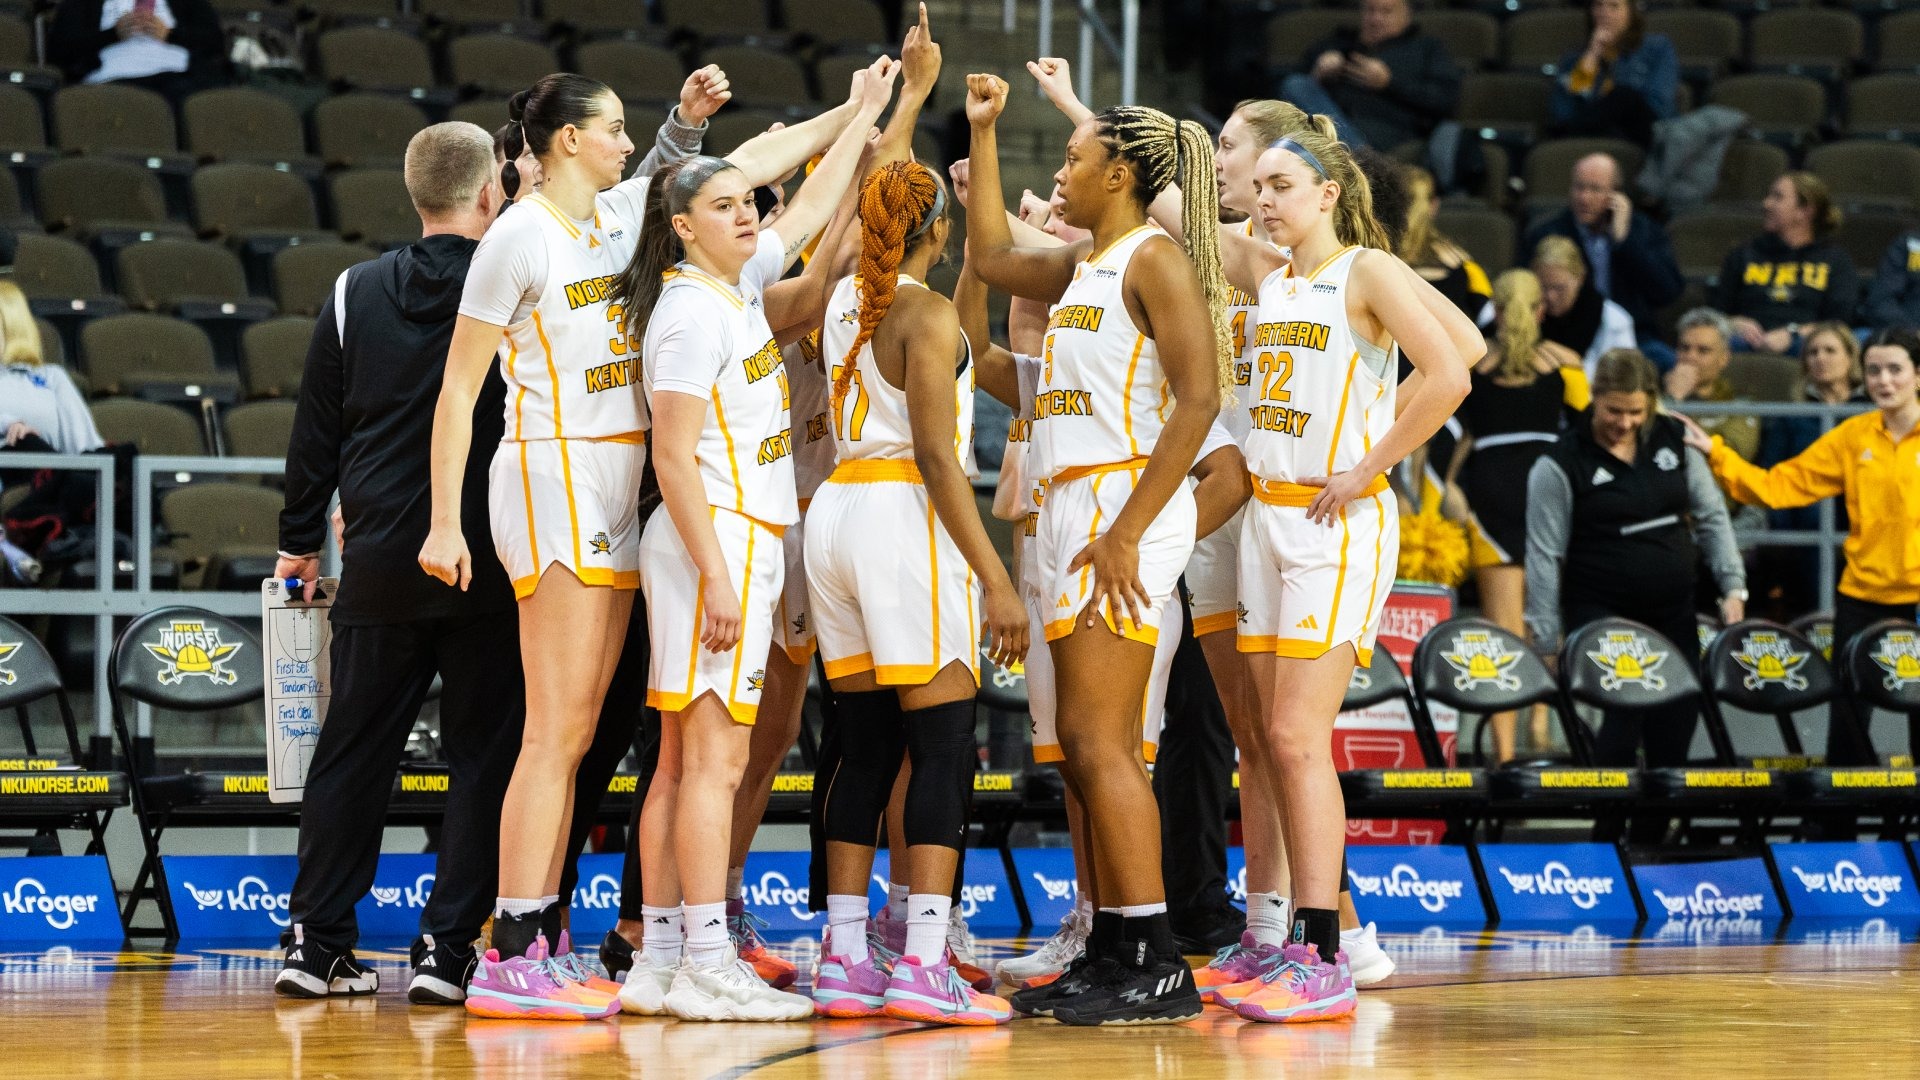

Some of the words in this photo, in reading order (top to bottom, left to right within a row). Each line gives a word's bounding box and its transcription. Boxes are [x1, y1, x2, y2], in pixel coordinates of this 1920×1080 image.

[1230, 310, 1248, 358] 4
[1257, 351, 1294, 402] 22
[163, 632, 217, 650] NORSE
[174, 623, 202, 632] NKU
[1, 776, 109, 794] NKUNORSE.COM
[1383, 772, 1473, 788] NKUNORSE.COM
[1540, 772, 1629, 788] NKUNORSE.COM
[3, 877, 99, 930] Kroger
[227, 875, 292, 927] Krog
[751, 871, 818, 920] Krog
[1383, 863, 1463, 913] Kroger
[1535, 861, 1614, 909] Kroger
[1687, 882, 1764, 917] Kroger
[1828, 860, 1902, 907] Kroger
